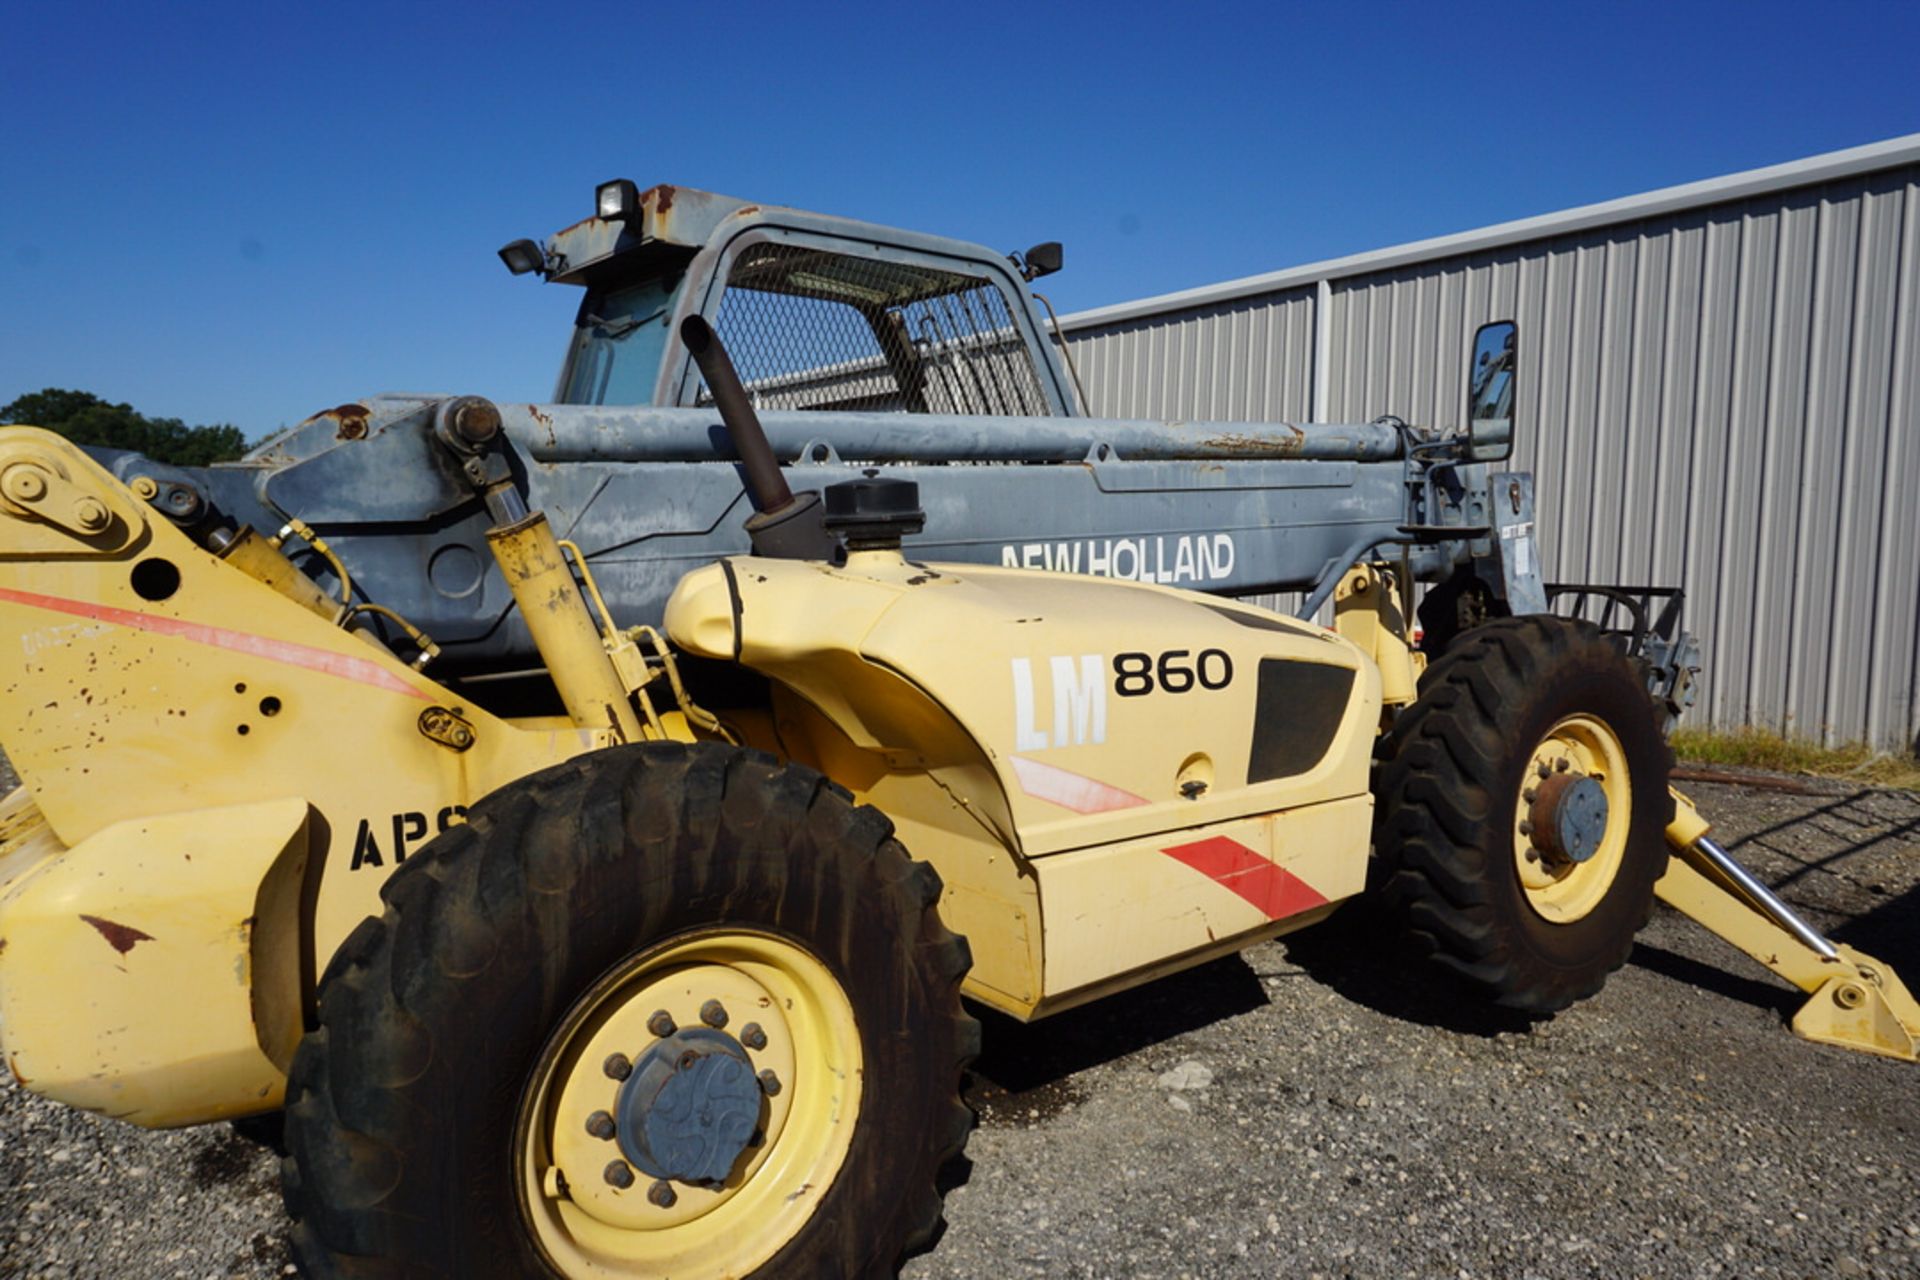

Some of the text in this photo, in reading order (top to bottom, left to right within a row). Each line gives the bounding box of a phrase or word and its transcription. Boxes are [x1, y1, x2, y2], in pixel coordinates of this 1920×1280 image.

[1088, 534, 1235, 583] HOLLAND
[1011, 648, 1233, 751] LM 860
